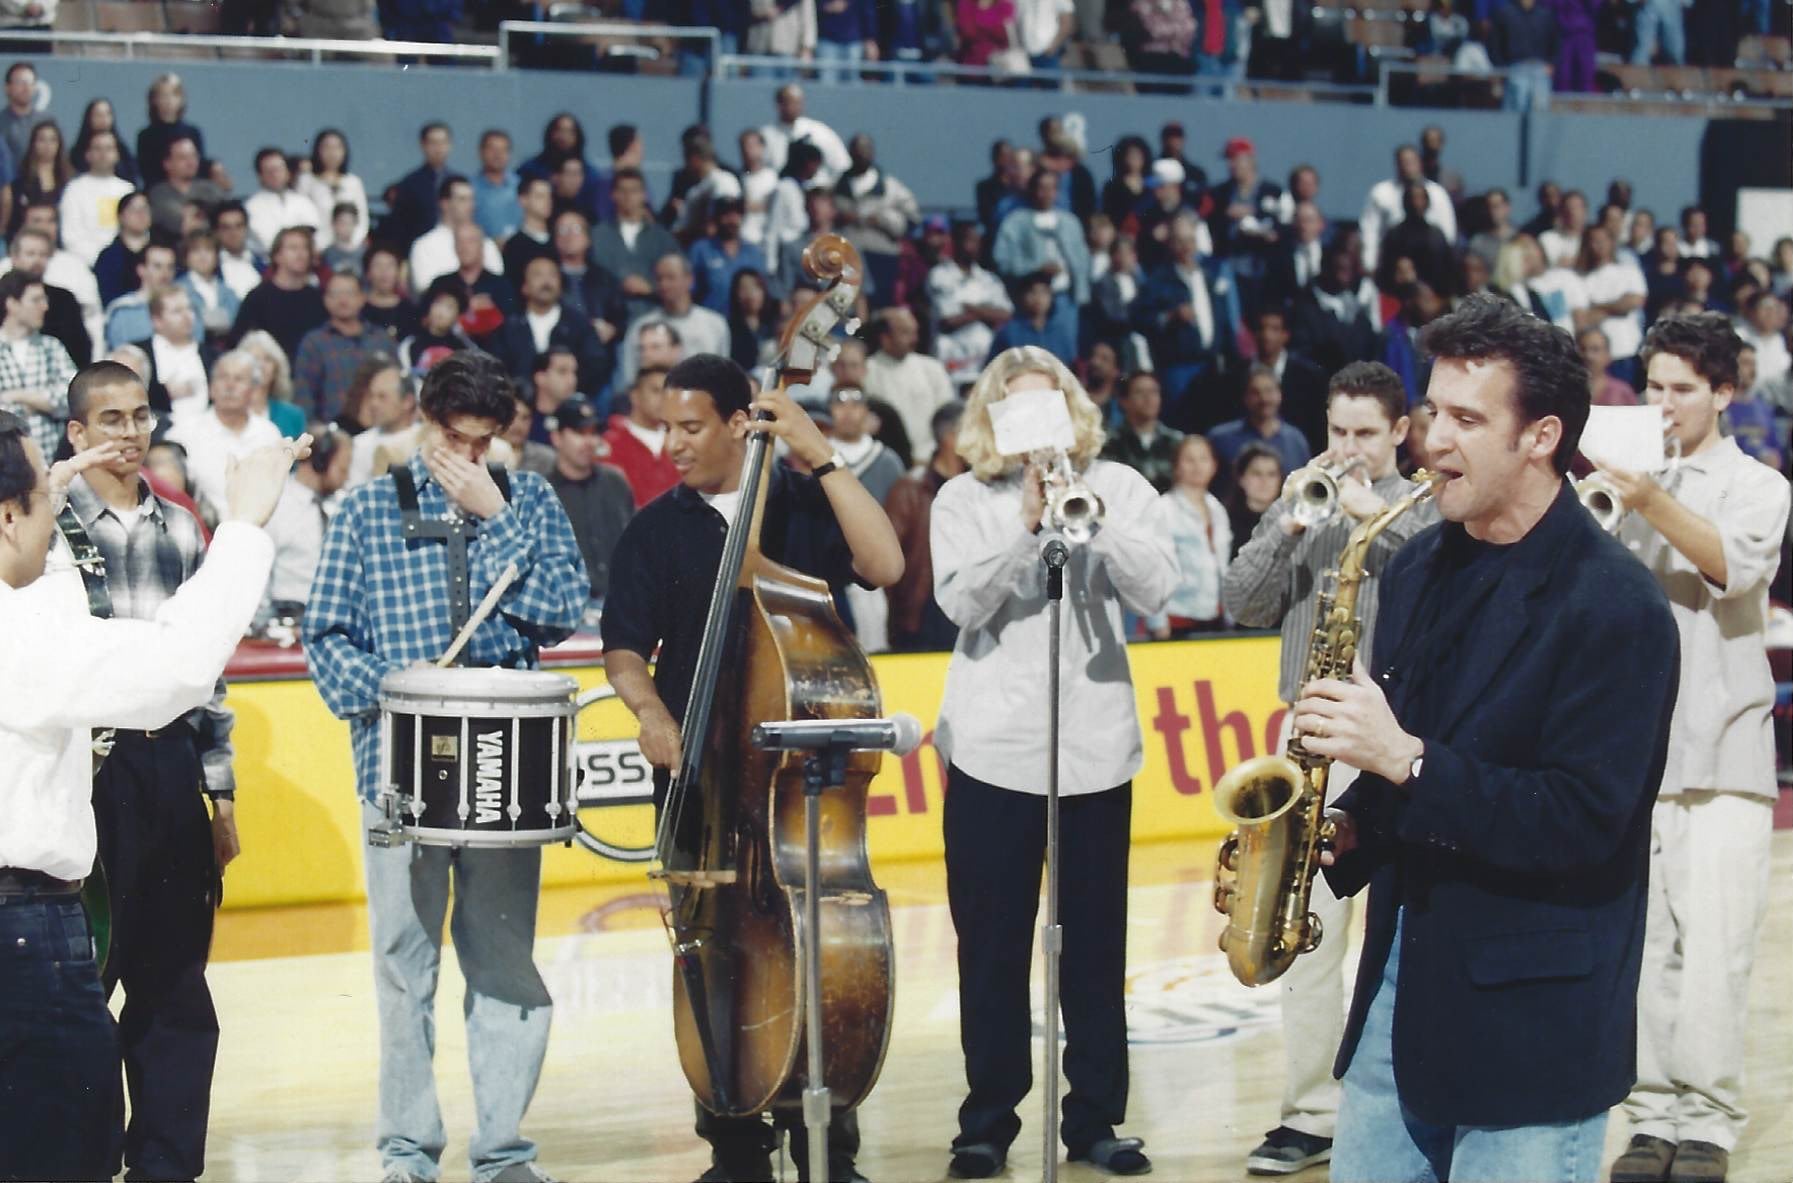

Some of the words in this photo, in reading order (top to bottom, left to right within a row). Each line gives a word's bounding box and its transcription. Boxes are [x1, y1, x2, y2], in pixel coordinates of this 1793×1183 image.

[476, 730, 503, 823] YAMAHA
[576, 752, 646, 785] SS
[1152, 679, 1288, 796] th
